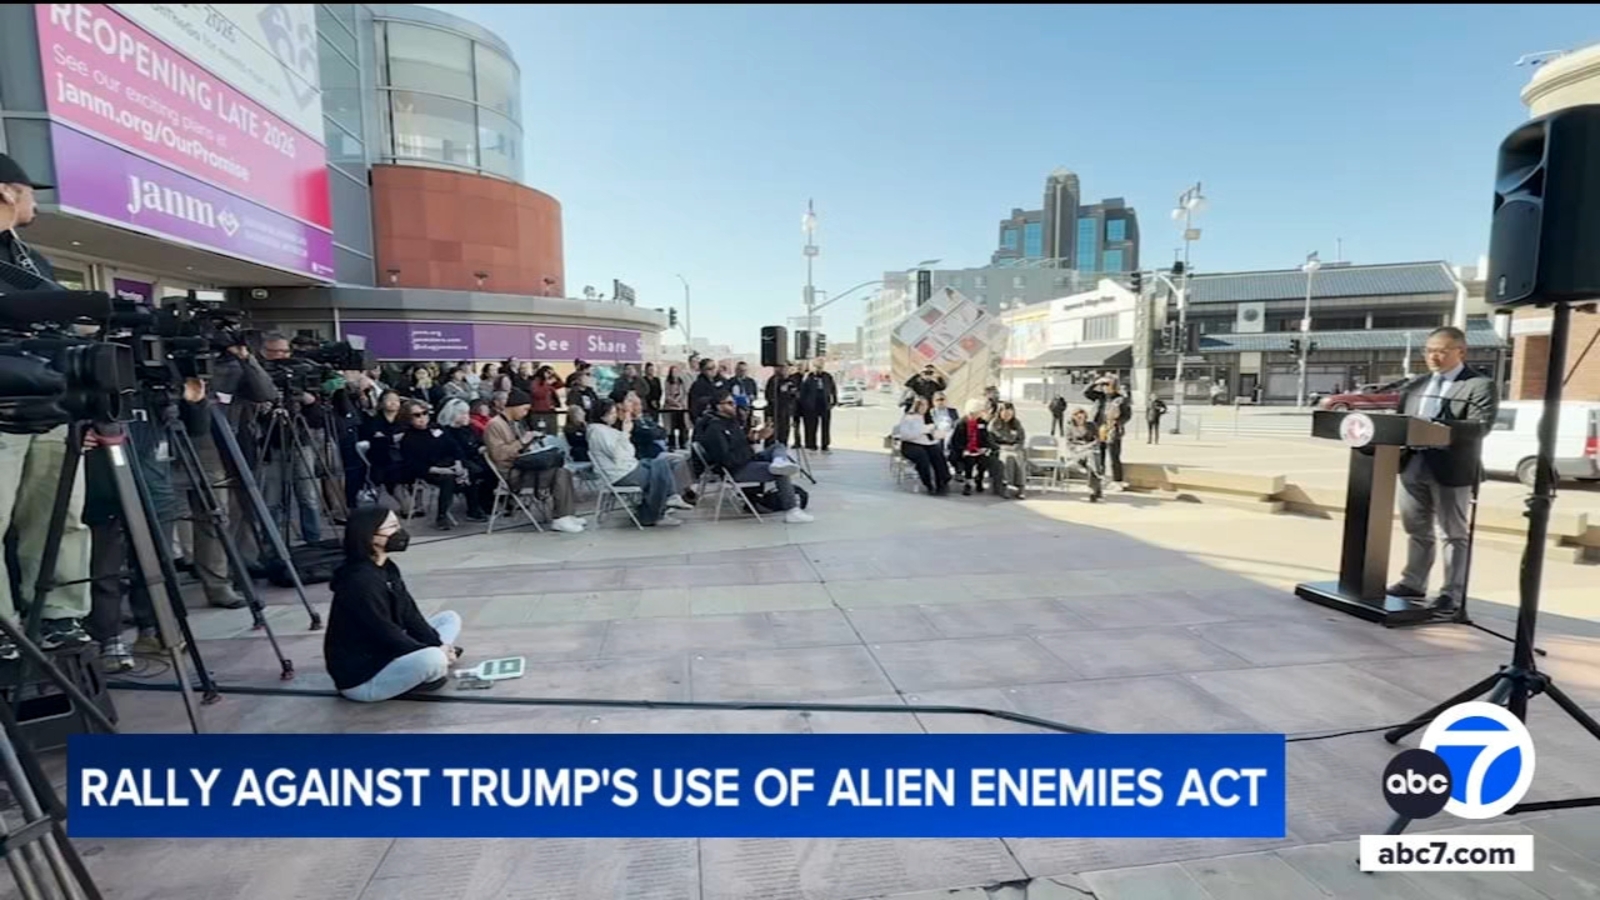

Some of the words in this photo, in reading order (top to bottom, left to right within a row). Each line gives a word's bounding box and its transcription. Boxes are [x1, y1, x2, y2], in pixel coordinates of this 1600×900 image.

[51, 4, 213, 110] REOPENING
[217, 91, 259, 139] LATE
[263, 121, 296, 159] 2026
[53, 44, 90, 77] See
[93, 69, 121, 93] our
[56, 72, 250, 182] janm.org/OurPromise
[127, 175, 217, 229] janm
[534, 332, 569, 351] See
[587, 335, 627, 353] Share
